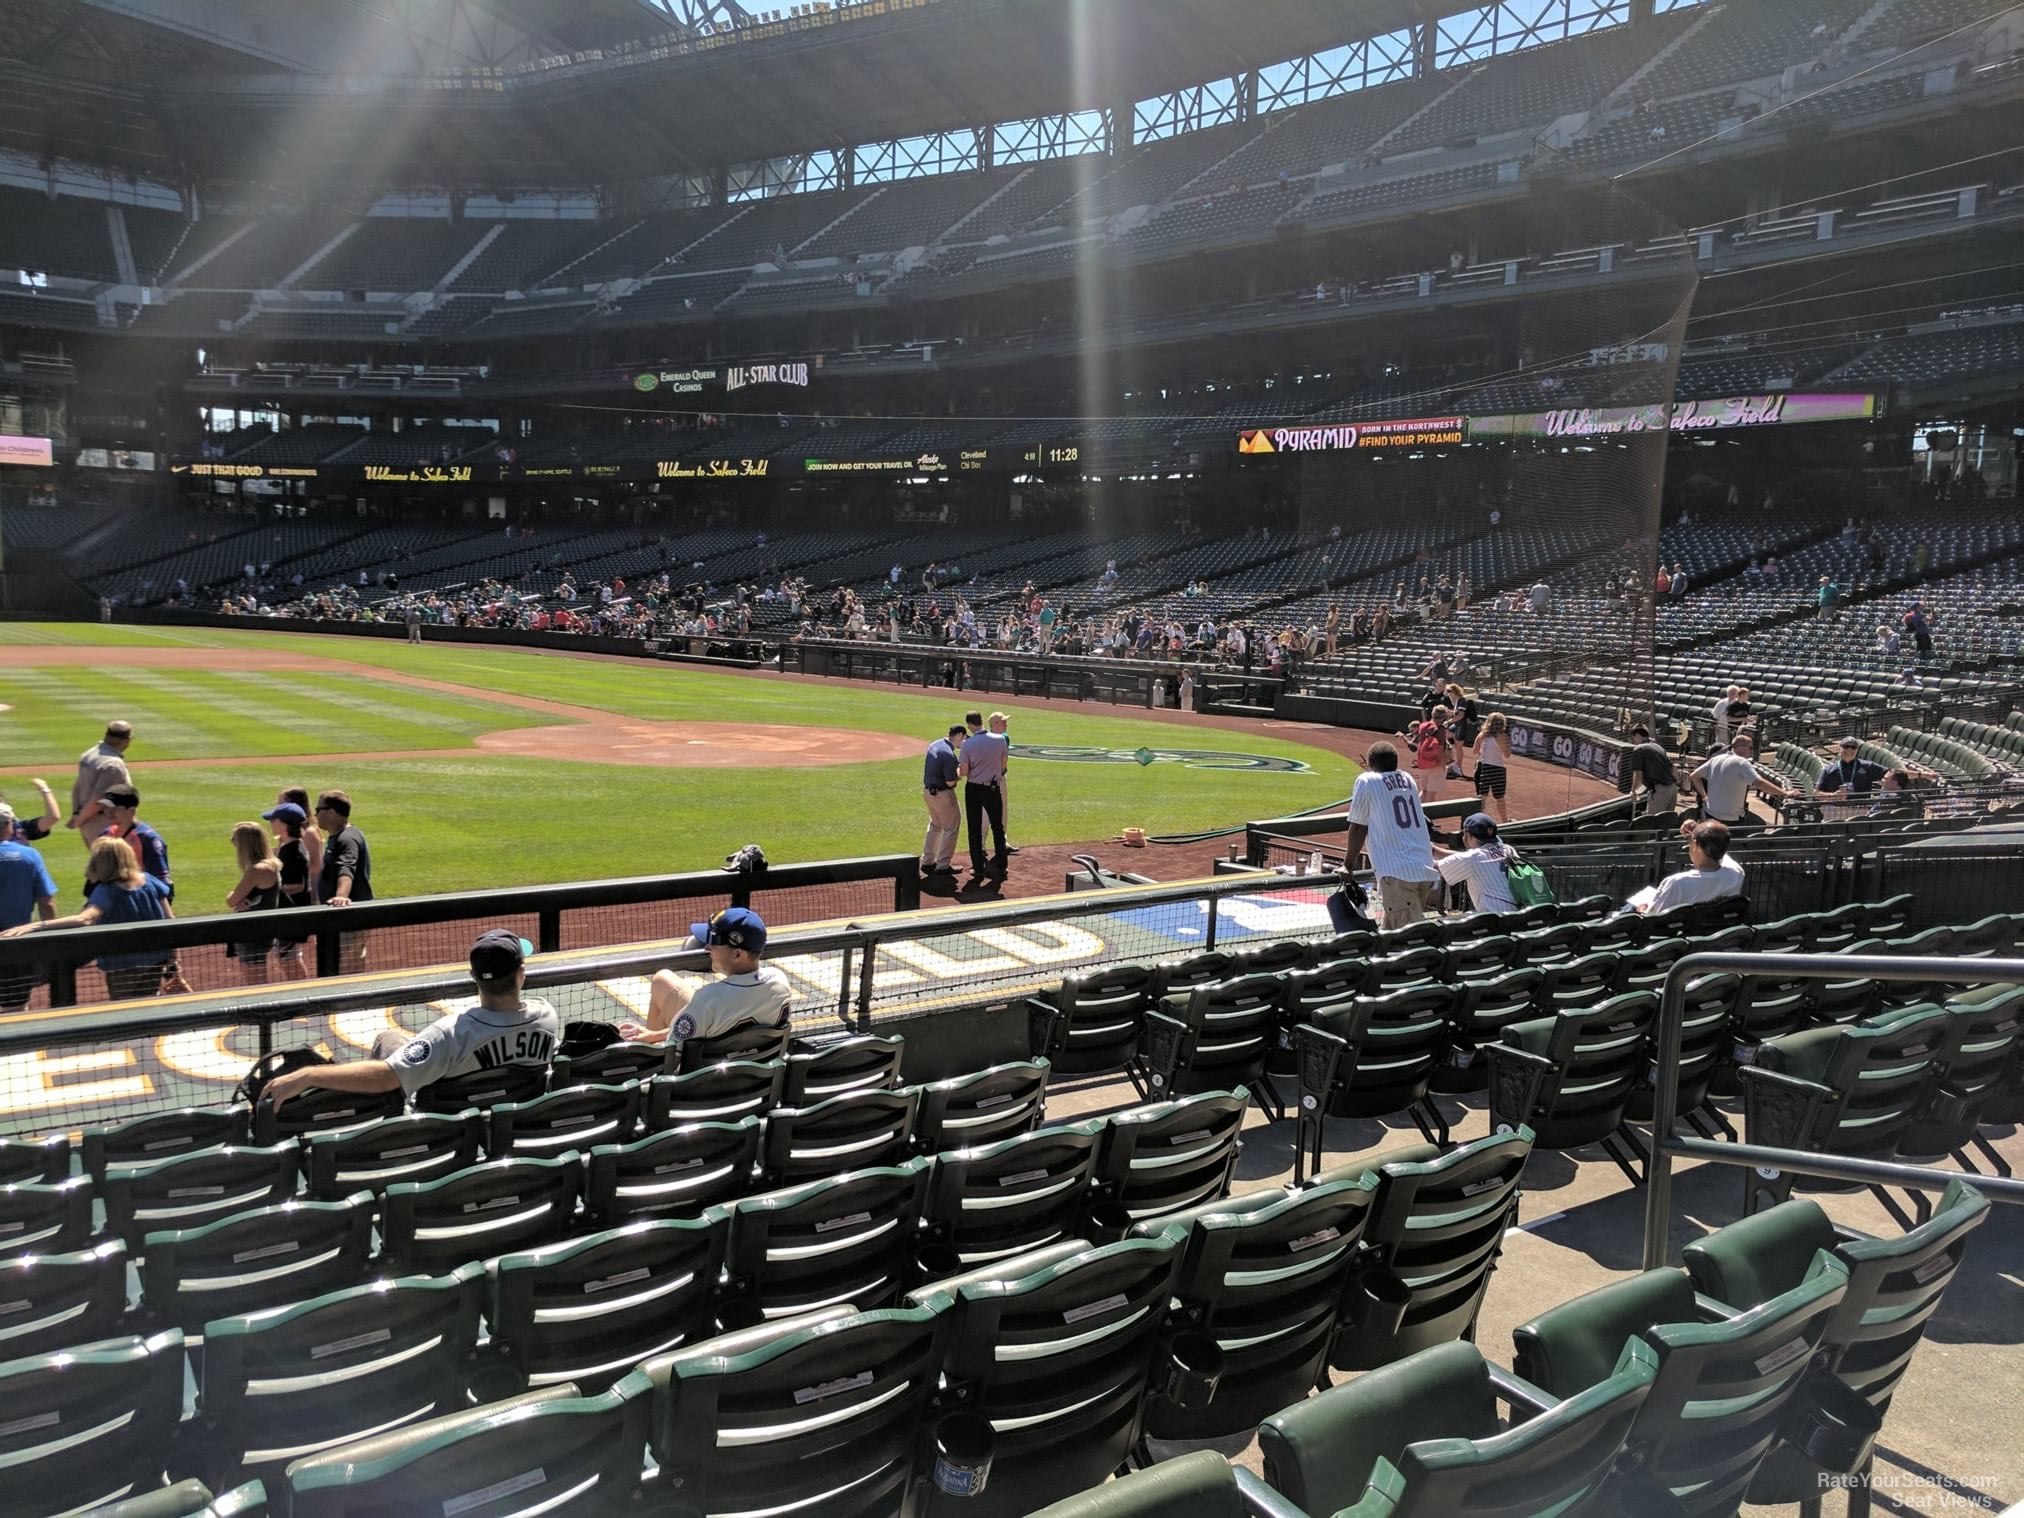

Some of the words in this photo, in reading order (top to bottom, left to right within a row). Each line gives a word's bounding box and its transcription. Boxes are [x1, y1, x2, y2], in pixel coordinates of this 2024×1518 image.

[660, 372, 691, 382] EMERALD
[692, 370, 716, 380] QUEEN
[779, 363, 808, 386] CLUB
[673, 382, 702, 392] CASINOS
[1719, 395, 1785, 425] Field
[1361, 426, 1382, 434] BORN
[1383, 424, 1392, 432] IN
[1393, 424, 1407, 432] THE
[1408, 420, 1454, 431] NORTHWEST
[1359, 436, 1388, 448] #FIND
[1390, 434, 1415, 446] YOUR
[1416, 432, 1462, 444] PYRAMID
[960, 450, 986, 460] Cleveland
[1050, 448, 1078, 462] 11:28
[658, 461, 696, 477] Welcome
[697, 465, 706, 476] to
[706, 460, 738, 477] Safeco
[740, 459, 768, 476] Field
[1511, 727, 1528, 746] GO
[1554, 736, 1572, 757] GO
[1579, 742, 1592, 764] GO
[1392, 795, 1420, 828] 01
[473, 1032, 552, 1069] WILSON
